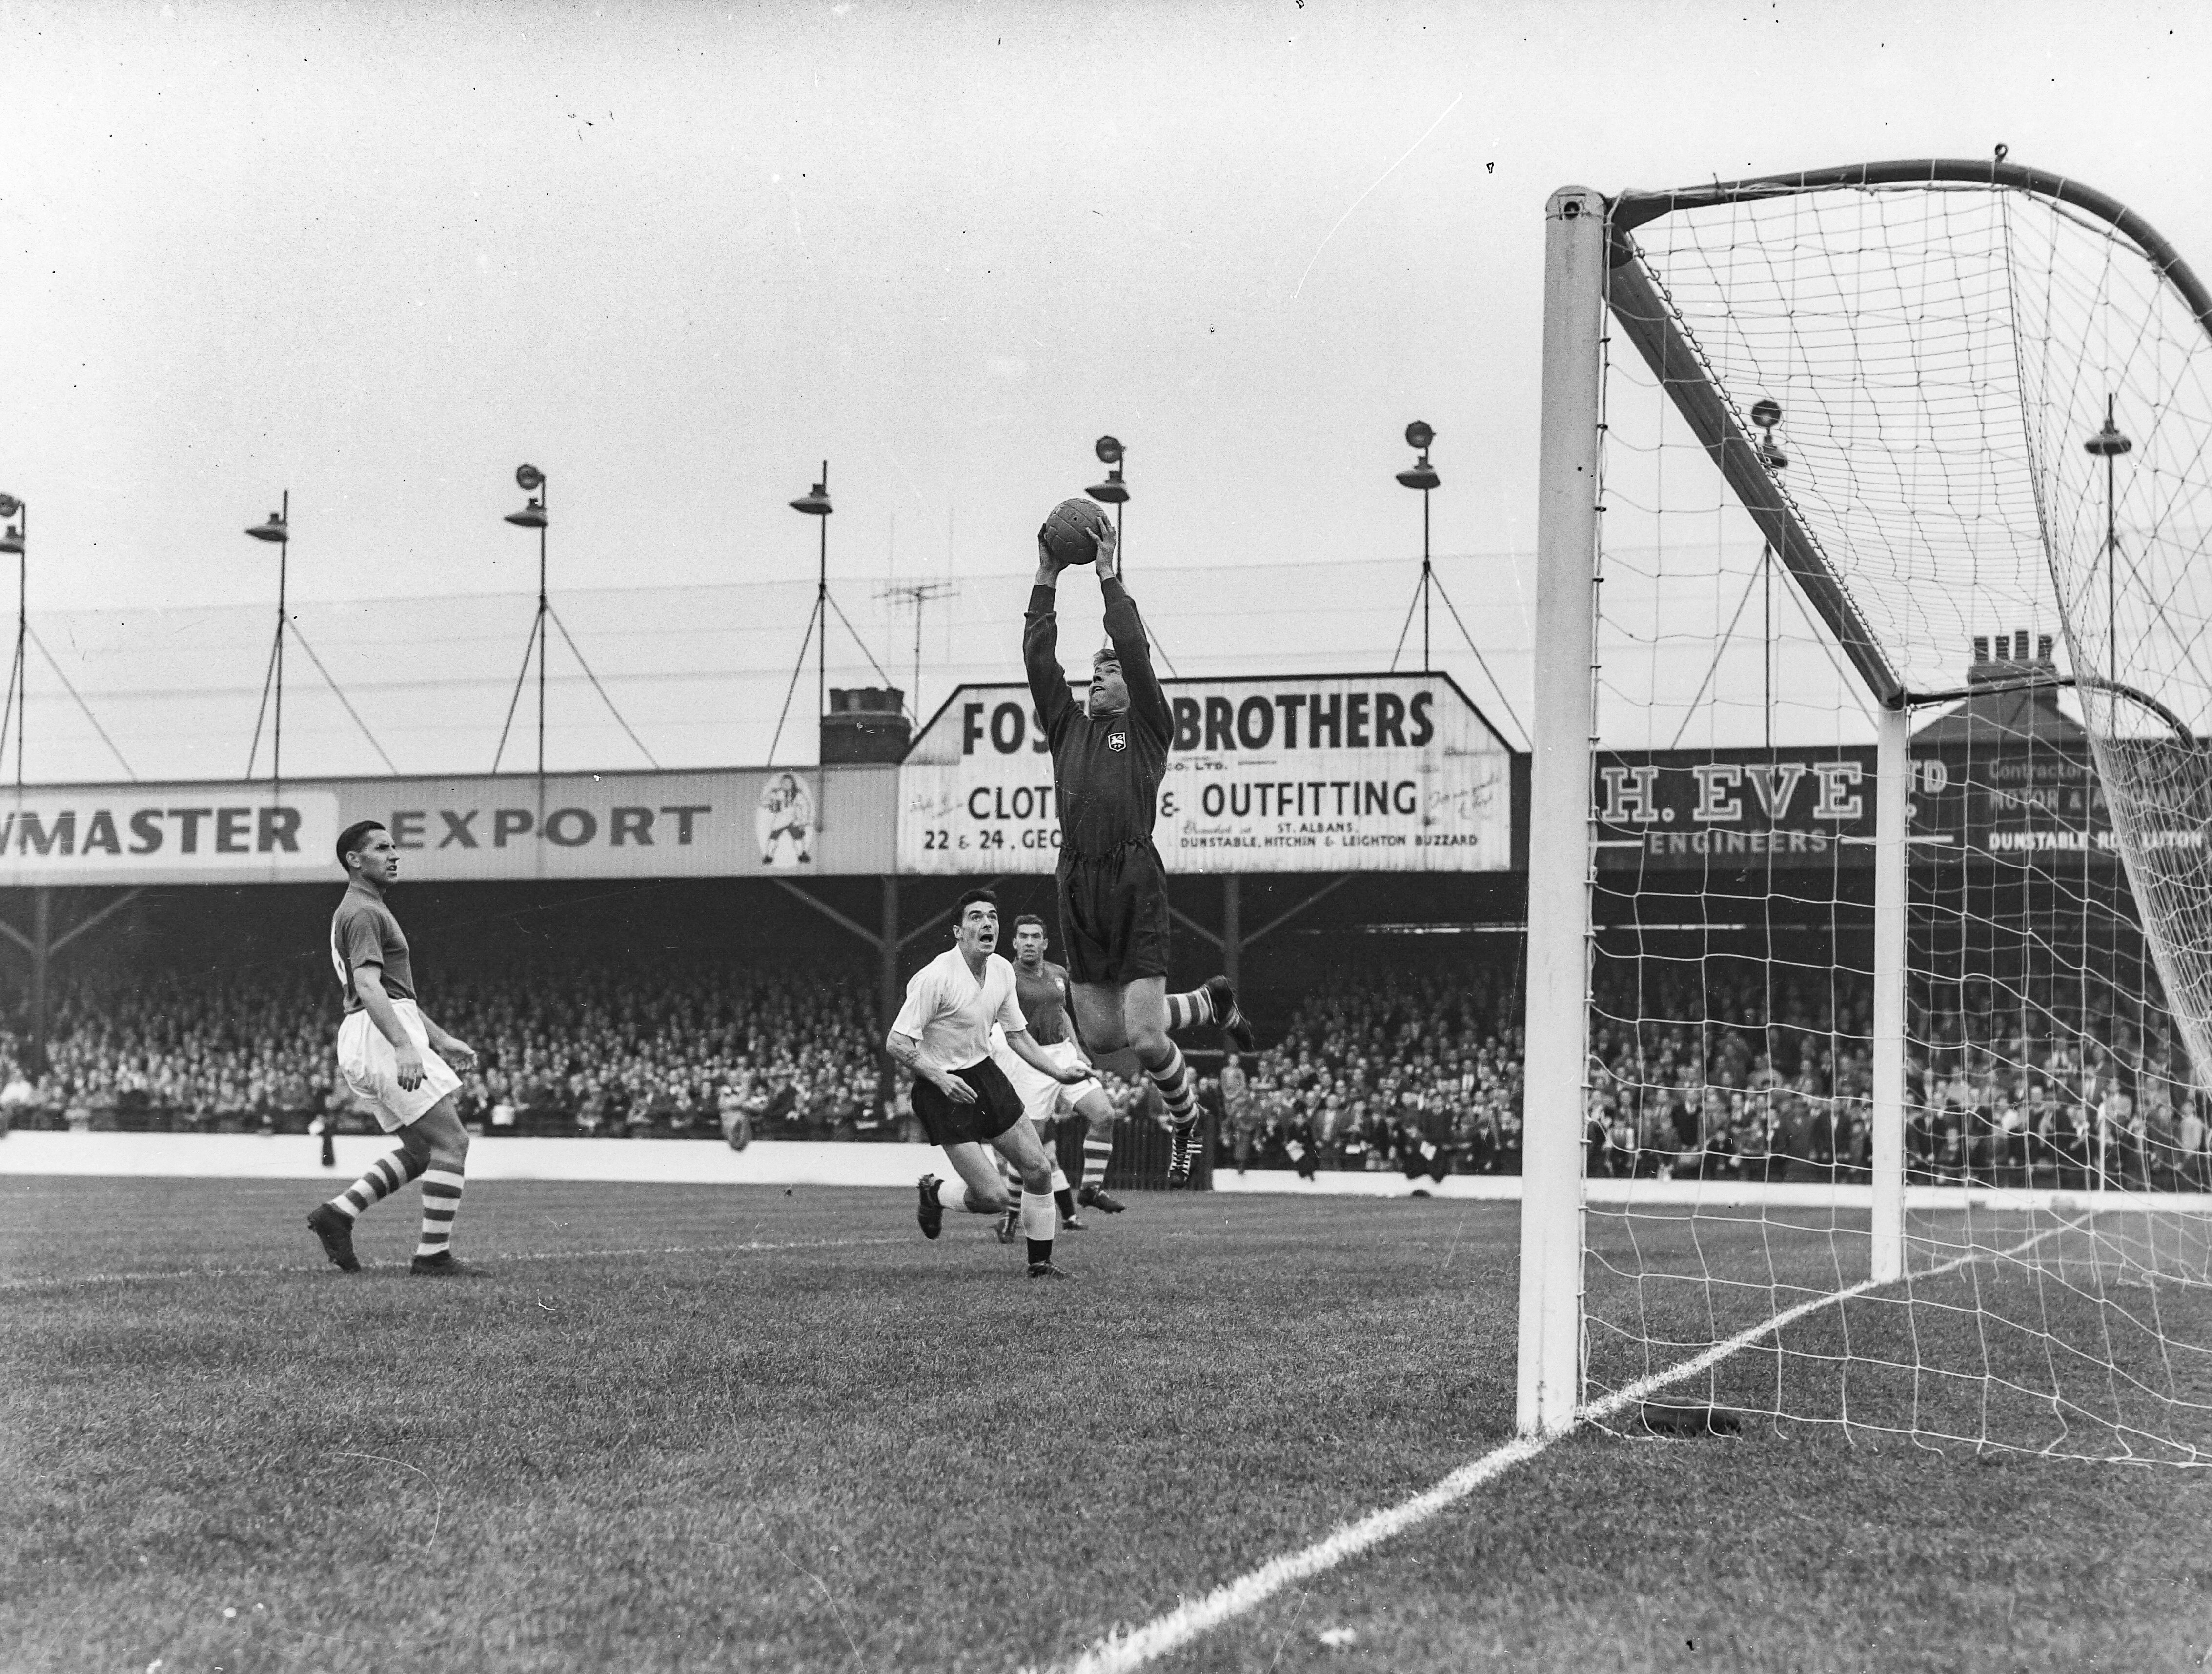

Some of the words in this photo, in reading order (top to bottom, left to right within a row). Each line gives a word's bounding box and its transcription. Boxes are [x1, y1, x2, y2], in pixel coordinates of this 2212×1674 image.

[1172, 691, 1434, 750] BROTHERS
[968, 787, 1060, 820] CLOT
[1161, 792, 1180, 818] &
[1202, 781, 1417, 818] OUTFITTING
[1601, 766, 1675, 823] H.
[1692, 761, 1863, 822] EVE
[391, 805, 712, 850] EXPORT
[924, 830, 949, 850] 22
[958, 835, 970, 850] &
[1264, 836, 1316, 847] HITCHIN
[1342, 834, 1406, 847] LEIGHTON
[1415, 834, 1478, 847] BUZZARD
[1649, 829, 1828, 855] ENGINEERS
[1989, 831, 2088, 851] DUNSTABLE
